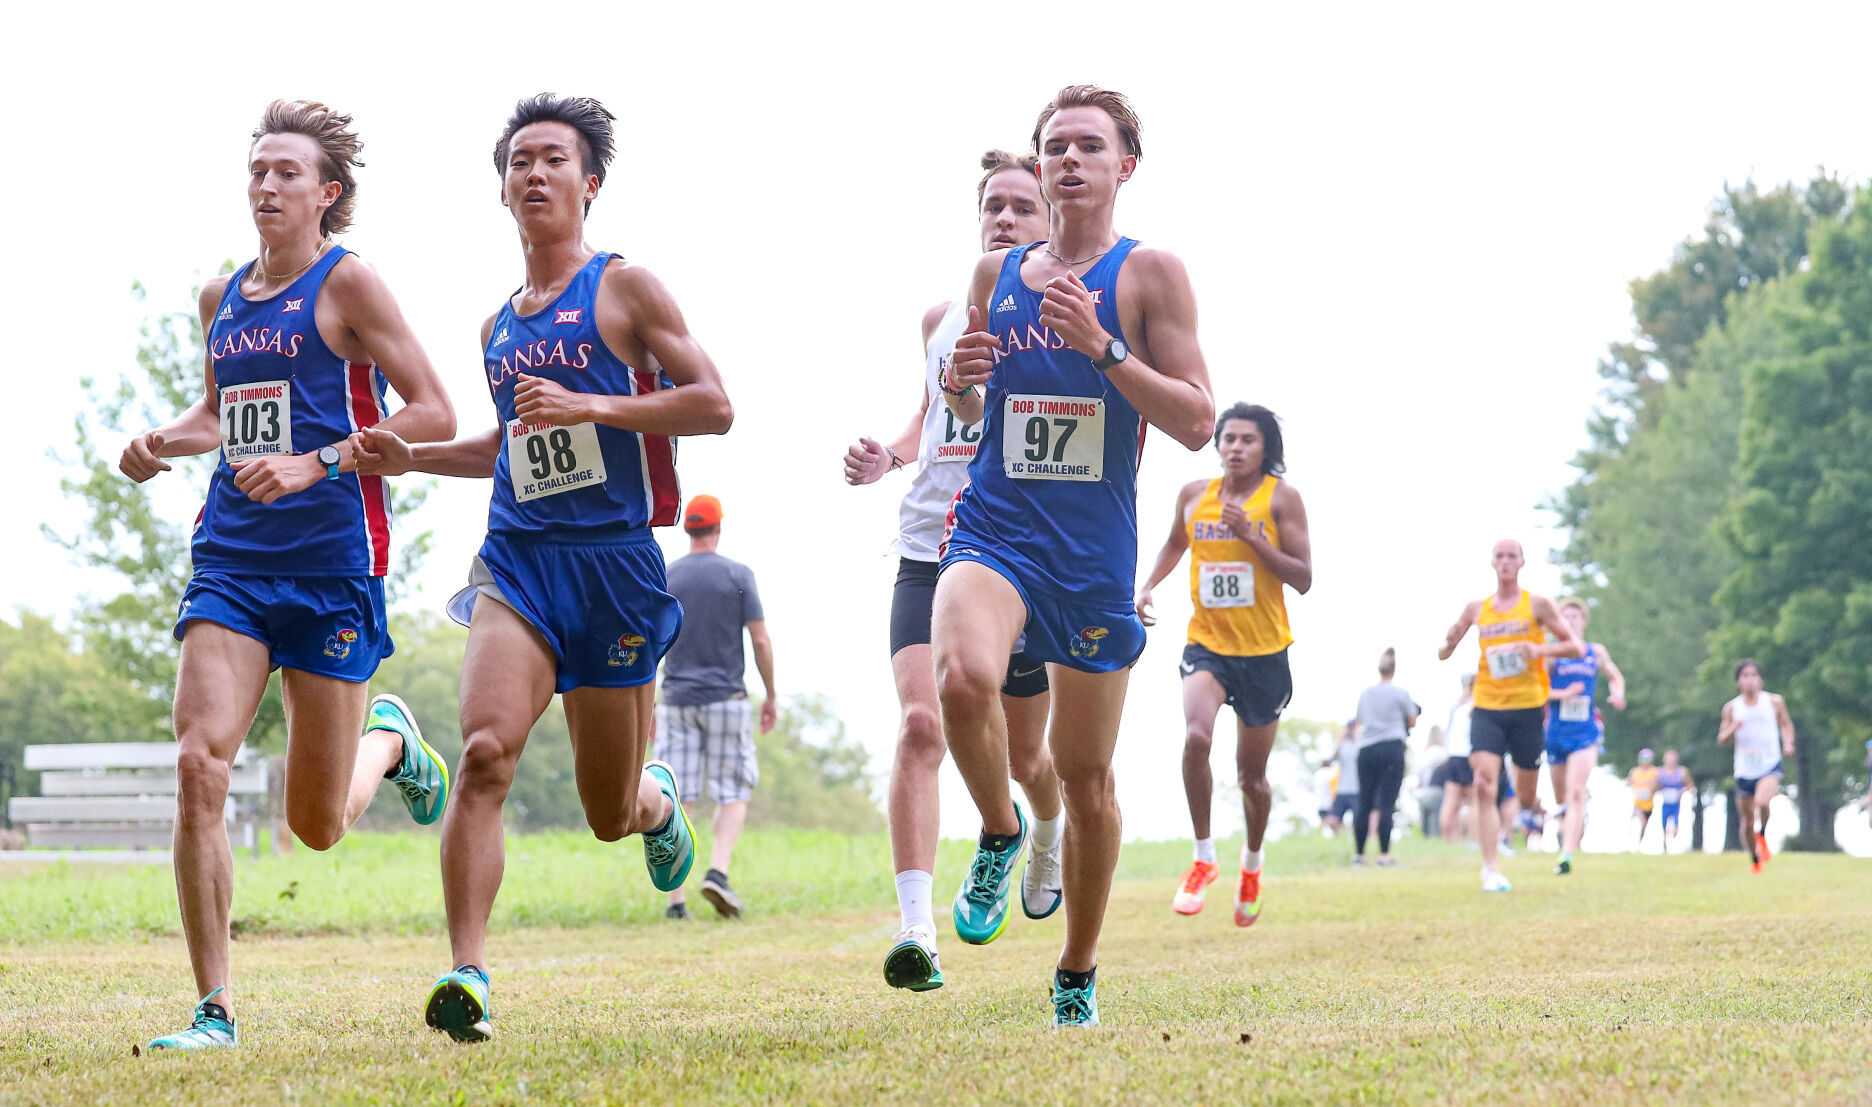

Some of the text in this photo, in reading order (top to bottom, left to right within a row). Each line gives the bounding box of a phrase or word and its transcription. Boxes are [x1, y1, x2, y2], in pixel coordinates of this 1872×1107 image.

[996, 305, 1018, 313] adidas
[211, 326, 305, 363] KANSAS
[992, 322, 1076, 365] KANS
[489, 337, 594, 391] KANSAS
[225, 386, 283, 405] BOB TIMMONS
[1012, 400, 1096, 417] BOB TIMMONS
[227, 400, 281, 446] 103
[512, 423, 530, 438] BOB
[1024, 416, 1078, 462] 97
[228, 447, 236, 458] XC
[236, 443, 282, 456] CHALLENGE
[526, 428, 577, 480] 98
[938, 445, 977, 457] IMMONS
[1012, 462, 1090, 475] XC CHALLENGE
[523, 483, 536, 495] XC
[537, 469, 594, 492] CHALLENGE
[1193, 521, 1268, 541] HASL
[1212, 574, 1240, 598] 88
